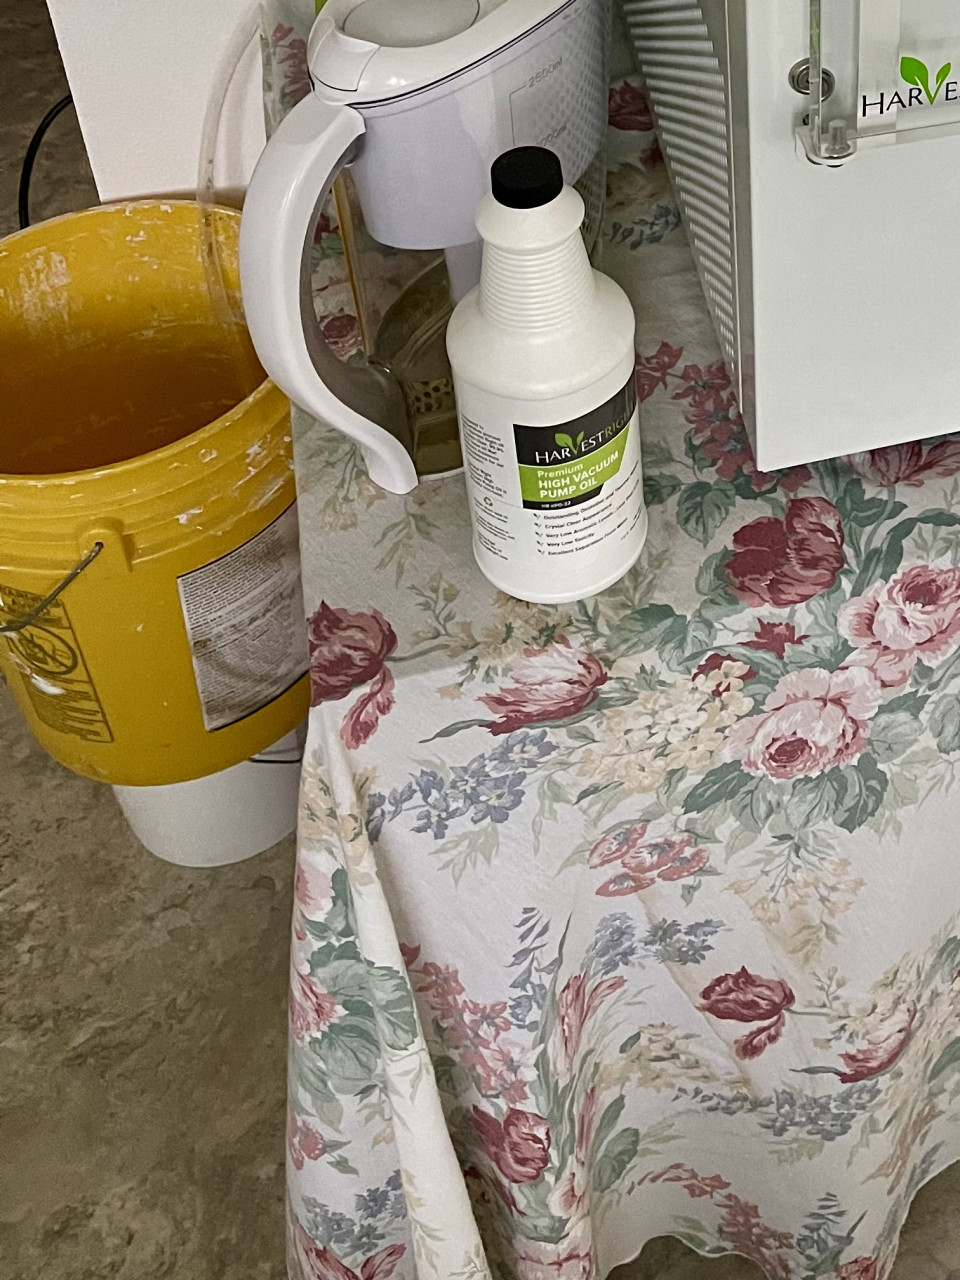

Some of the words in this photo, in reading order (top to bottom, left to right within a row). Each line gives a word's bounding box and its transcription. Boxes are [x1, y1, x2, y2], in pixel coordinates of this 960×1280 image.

[537, 463, 584, 478] Premium
[538, 476, 571, 490] HIGH
[572, 450, 620, 483] VACUUM
[540, 485, 577, 499] PUMP
[579, 477, 599, 491] OIL
